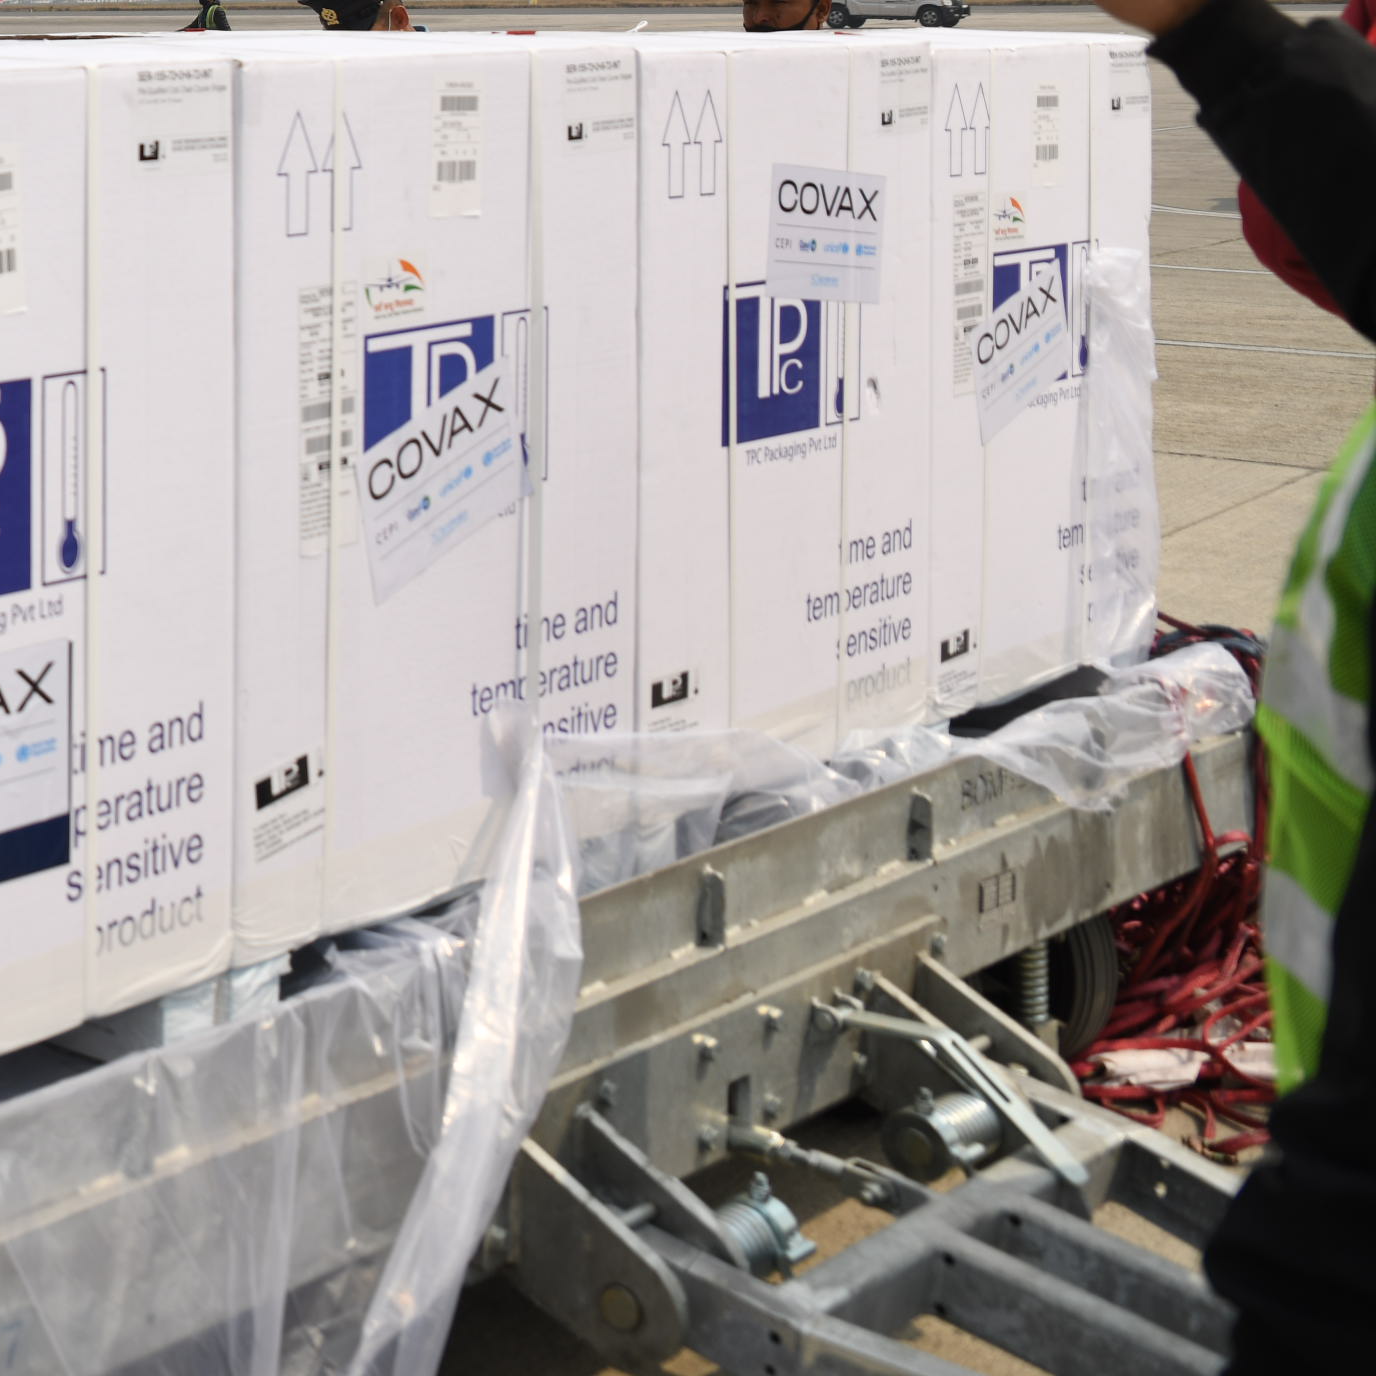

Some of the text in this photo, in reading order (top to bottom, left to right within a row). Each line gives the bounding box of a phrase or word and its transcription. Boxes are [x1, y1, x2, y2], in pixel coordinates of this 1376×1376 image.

[778, 179, 879, 222] COVAX
[977, 275, 1057, 365] COVAX
[368, 377, 504, 501] COVAX
[745, 434, 838, 466] TPC Packaging Pvt Ltd
[882, 517, 913, 557] and
[11, 602, 36, 624] Pvt
[38, 595, 64, 620] Ltd
[574, 589, 619, 635] and
[148, 700, 204, 755] and
